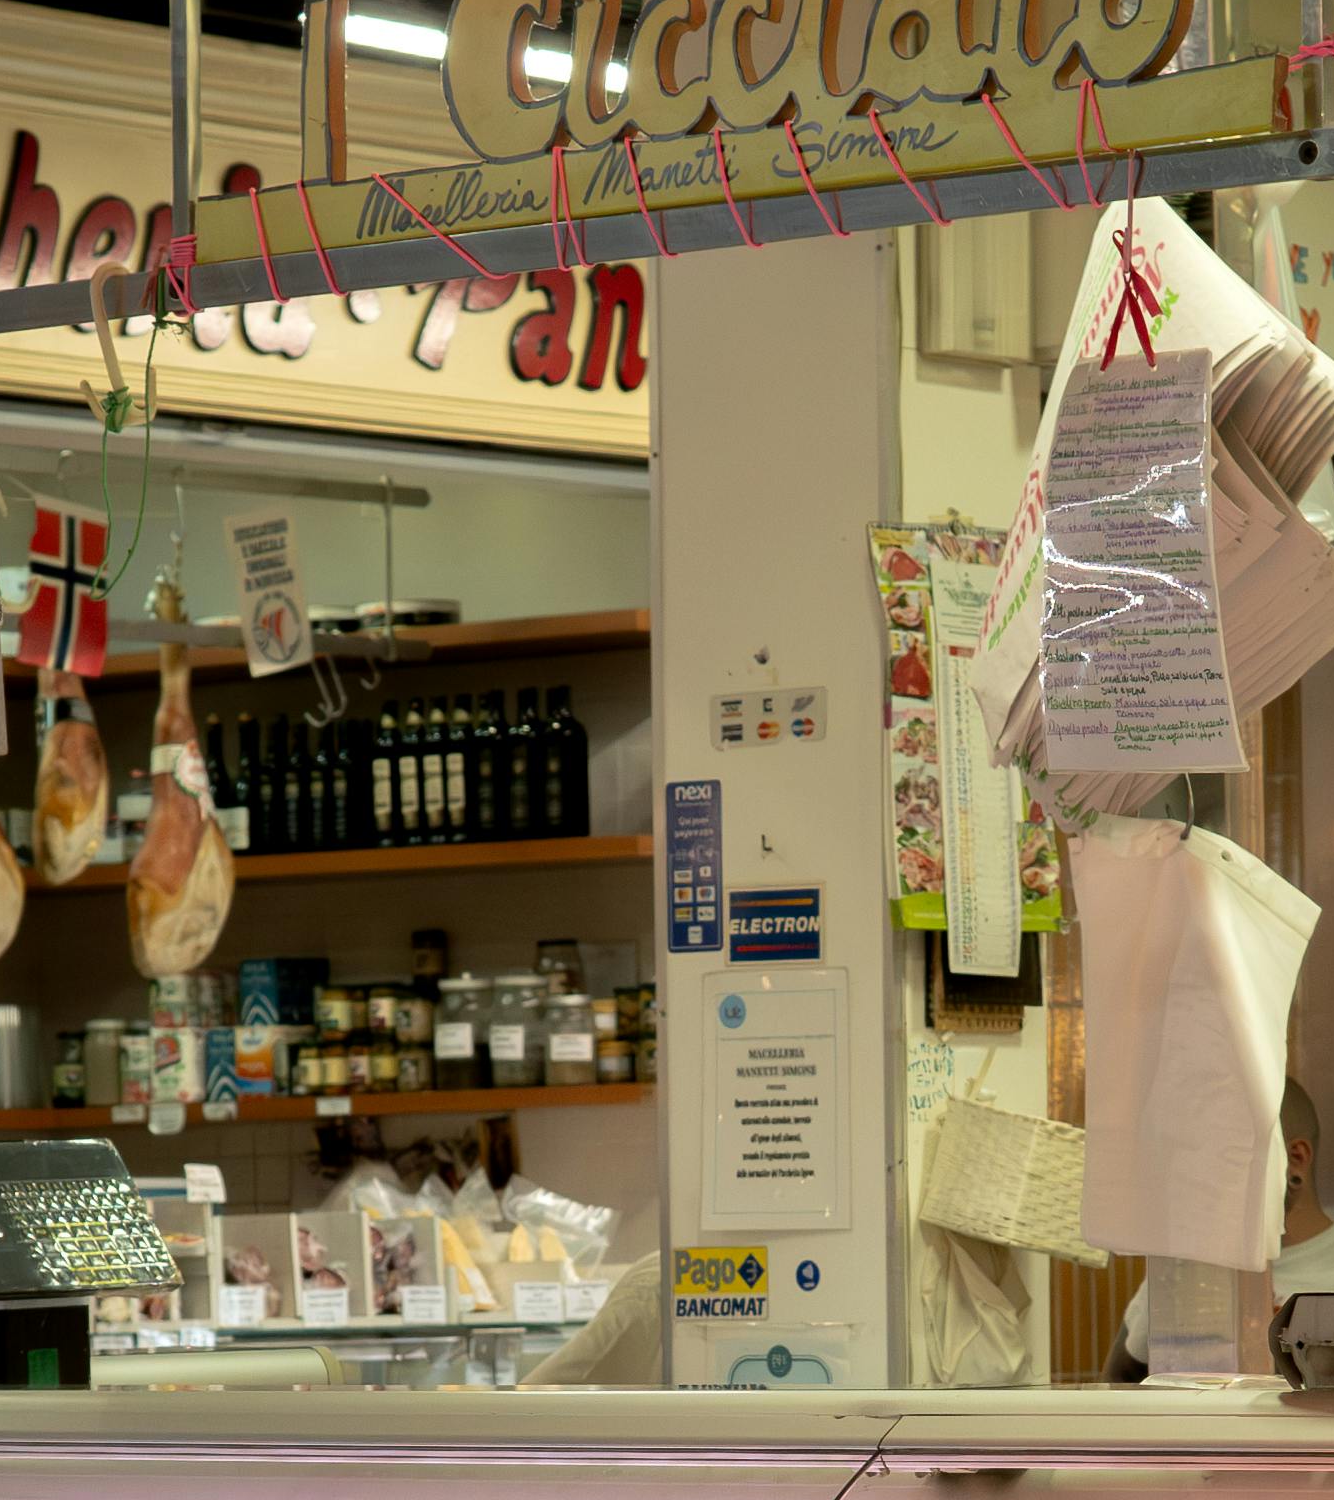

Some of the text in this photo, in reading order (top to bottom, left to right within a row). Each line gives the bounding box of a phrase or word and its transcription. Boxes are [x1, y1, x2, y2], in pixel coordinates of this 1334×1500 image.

[355, 118, 960, 240] Macelleria Manetti Simone
[674, 784, 713, 801] nexi
[729, 915, 820, 935] ELECTRON
[748, 1048, 806, 1060] MACELLERIA
[674, 1249, 736, 1292] Pago
[675, 1297, 766, 1317] BANCOMAT
